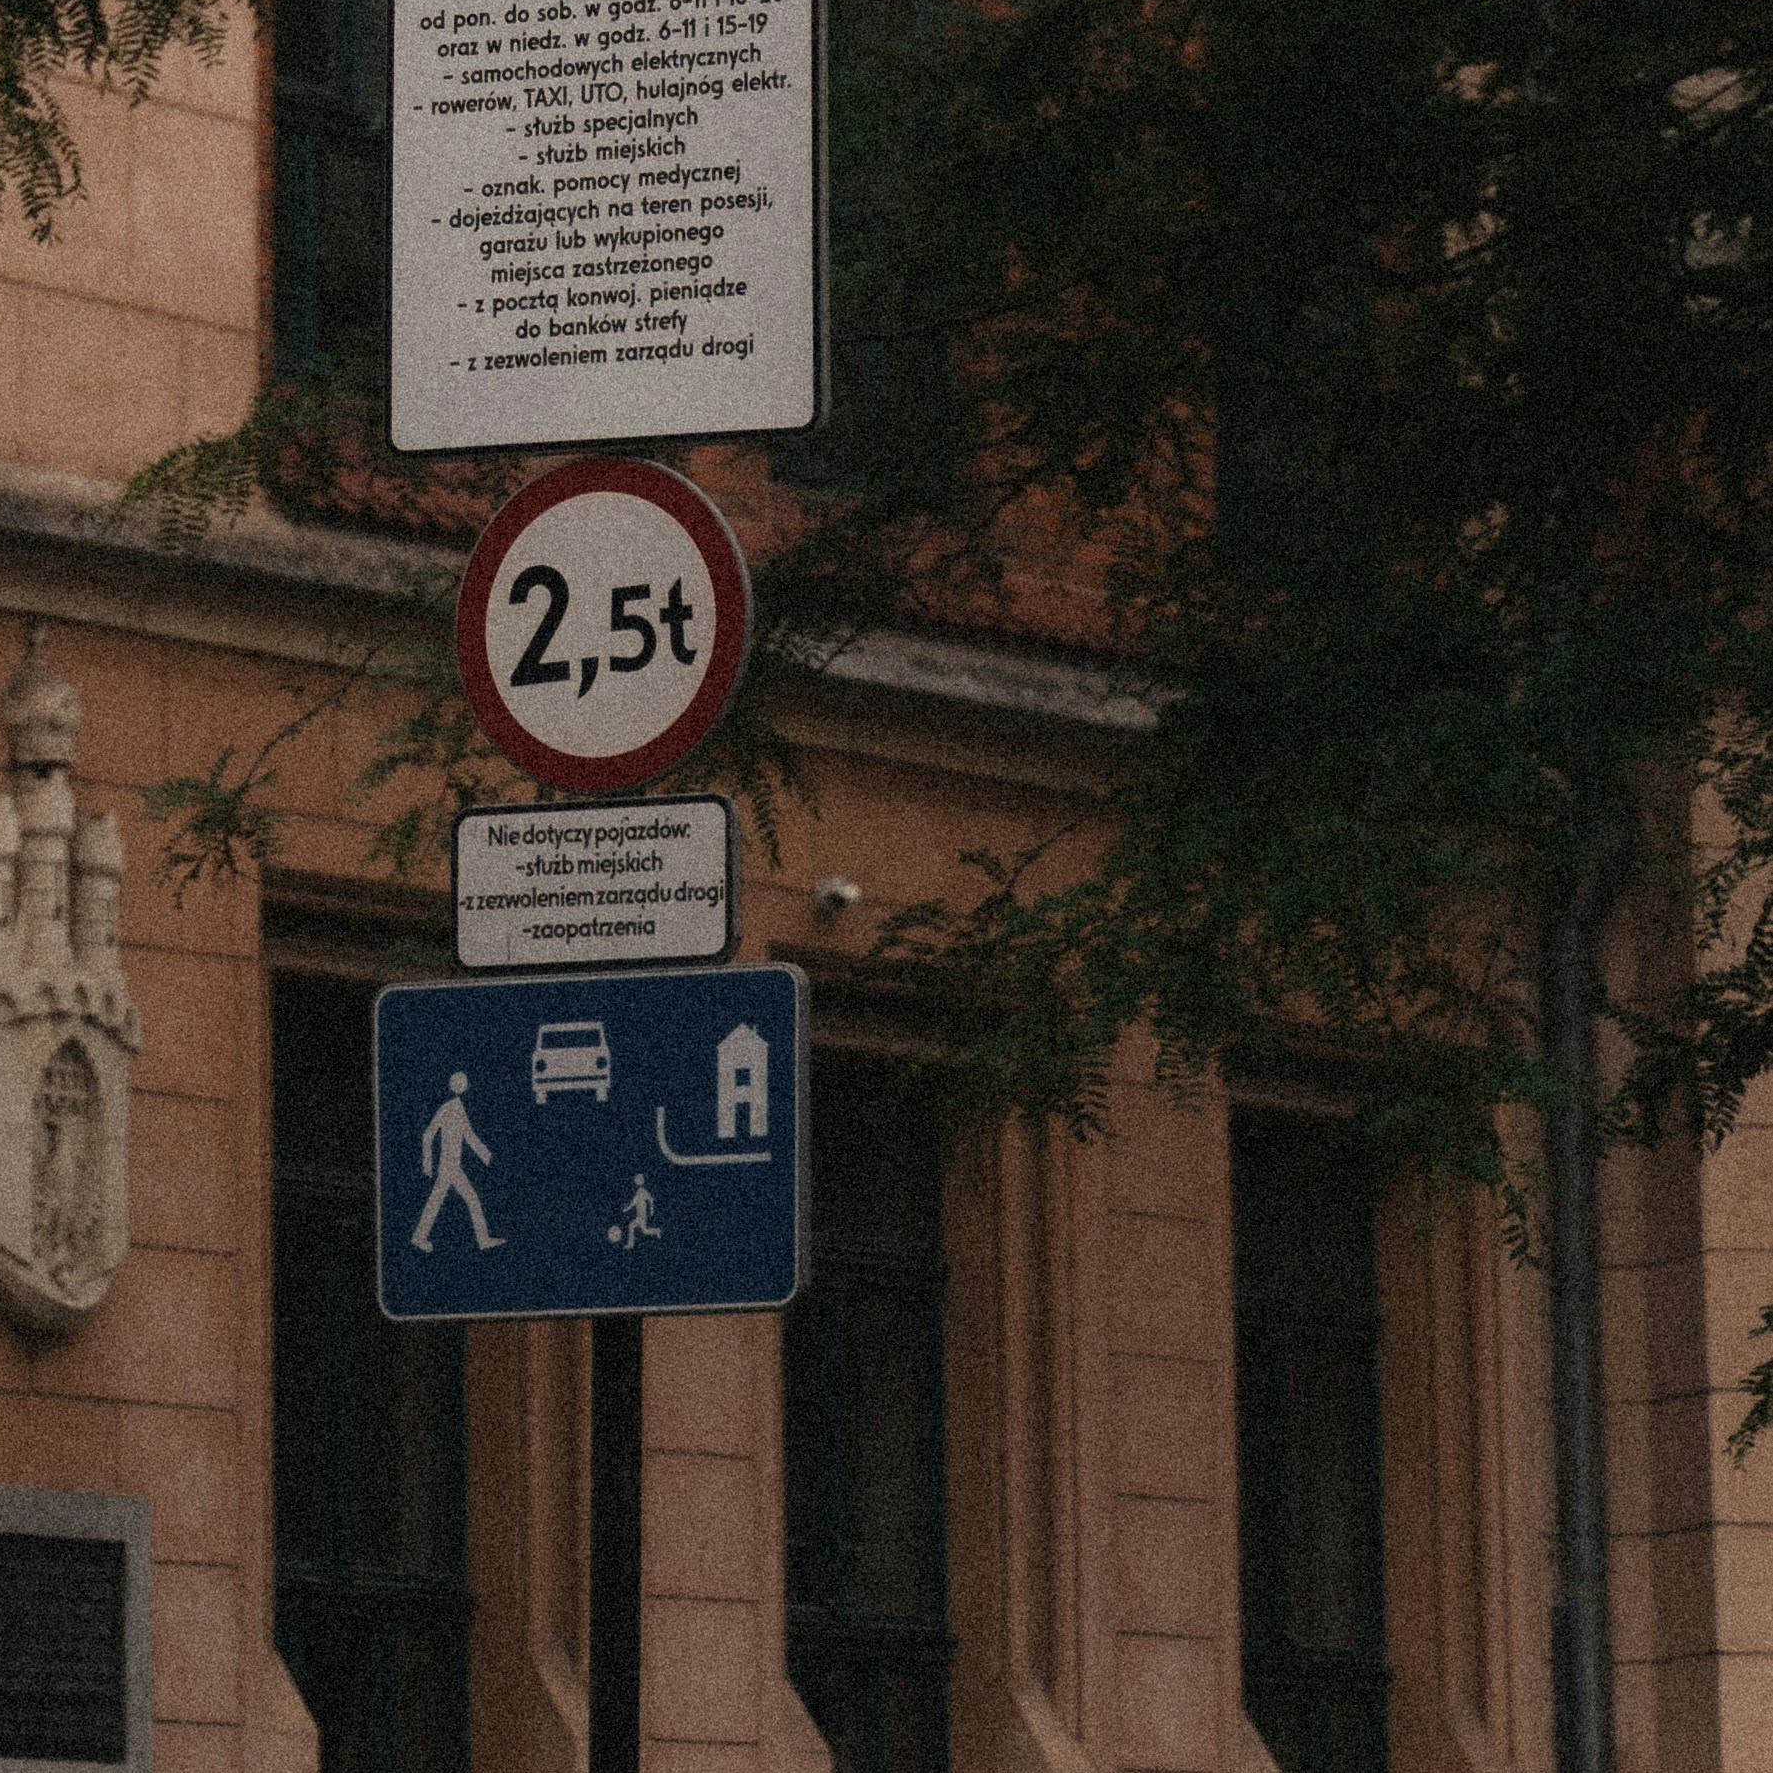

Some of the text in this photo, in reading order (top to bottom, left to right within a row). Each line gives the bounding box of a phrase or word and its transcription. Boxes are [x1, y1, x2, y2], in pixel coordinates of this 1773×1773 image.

[419, 9, 446, 31] od
[453, 12, 496, 35] pon.
[504, 3, 530, 25] do
[537, 0, 577, 23] sob.
[584, 2, 601, 18] w
[436, 12, 769, 58] oraz w niedz. w godz. 6-11 i 15-19
[460, 52, 624, 85] samochodowych
[630, 42, 762, 74] elektrycznych
[431, 91, 517, 115] rowerów,
[523, 85, 573, 109] TAXI,
[580, 81, 628, 105] UTO,
[636, 74, 724, 103] hulajnóg
[731, 69, 792, 93] elektr.
[524, 113, 576, 138] służb
[582, 105, 699, 139] specjalnych
[536, 142, 588, 166] służb
[595, 134, 686, 164] miejskich
[481, 174, 545, 198] oznak.
[553, 173, 631, 199] pomocy
[638, 158, 741, 190] medycznej
[448, 198, 600, 233] dojeżdżających
[607, 202, 634, 218] na
[640, 196, 693, 215] teren
[700, 185, 774, 218] posesji,
[479, 222, 725, 262] garażu lub wykupionego
[490, 253, 714, 287] miejsca zastrzeżonego
[475, 298, 485, 314] z
[492, 289, 559, 319] pocztą
[566, 282, 642, 309] konwoj.
[649, 276, 748, 308] pieniądze
[515, 308, 688, 340] do banków strefy
[467, 356, 477, 372] z
[484, 344, 608, 371] zezwoleniem
[615, 337, 694, 365] zarządu
[701, 332, 754, 361] drogi
[507, 563, 698, 701] 2,5t
[487, 817, 691, 850] Nie dotyczy pojazdów:
[577, 850, 664, 880] miejskich
[476, 885, 595, 910] zezwoleniem
[596, 882, 672, 909] zarządu
[674, 880, 725, 908] drogi
